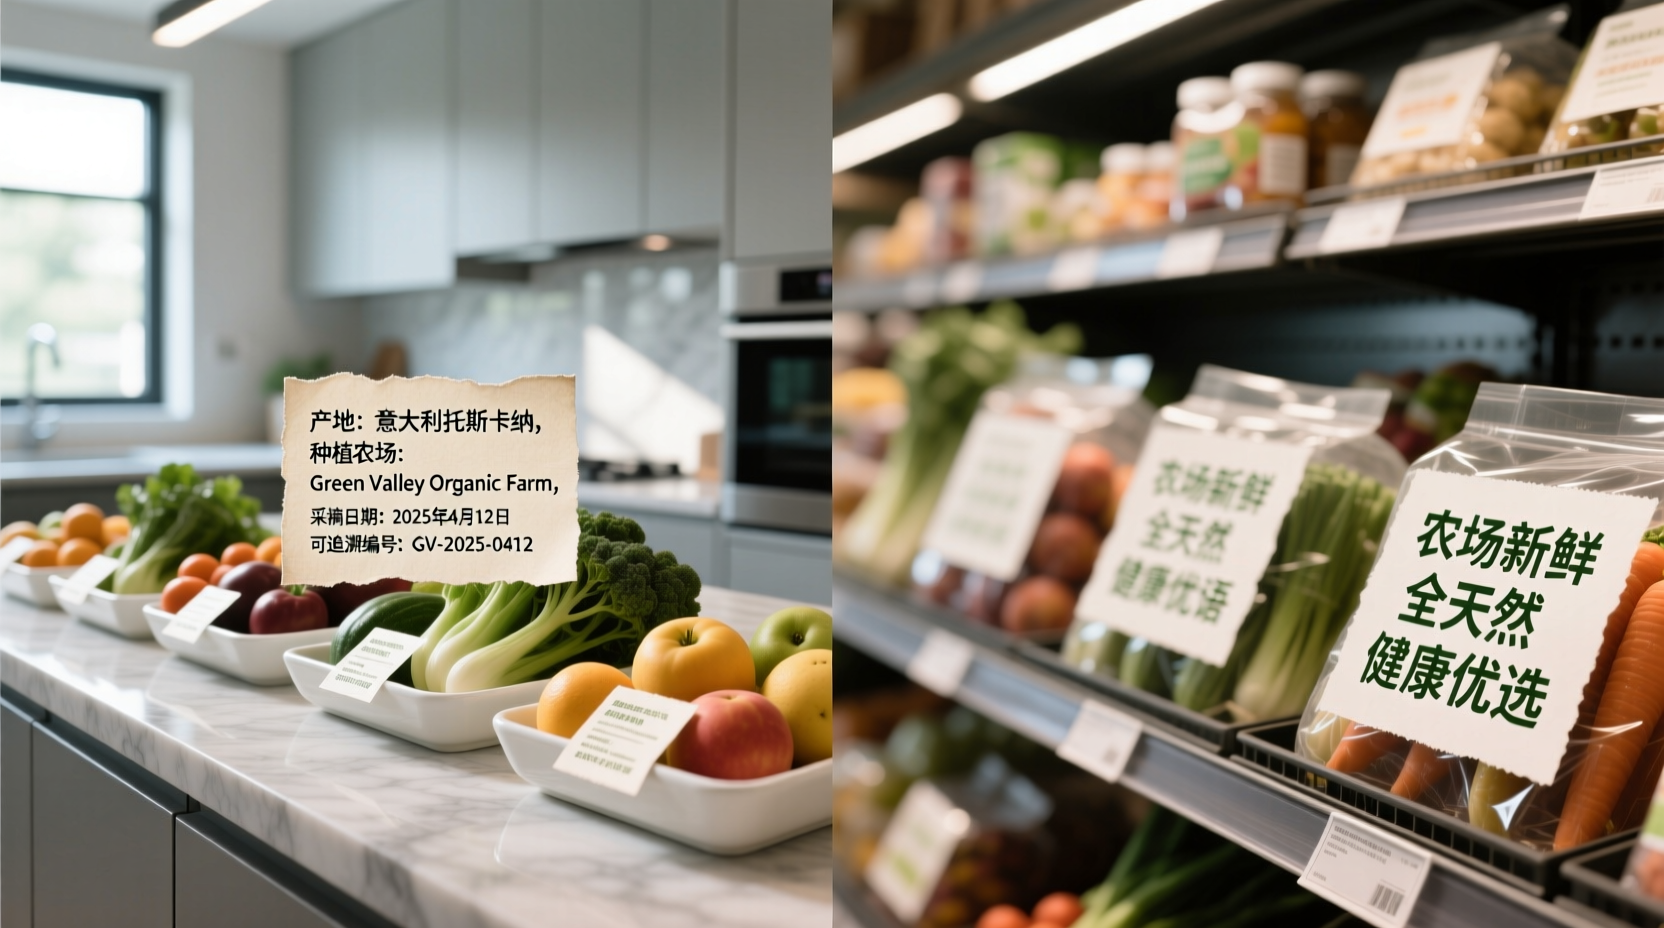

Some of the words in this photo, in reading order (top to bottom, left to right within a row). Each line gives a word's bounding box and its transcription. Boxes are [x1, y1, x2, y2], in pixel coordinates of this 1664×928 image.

[310, 474, 365, 492] Green
[369, 473, 425, 496] Valley
[429, 473, 502, 496] Organic
[506, 474, 559, 495] Farm,
[1141, 509, 1234, 563] 全天然
[1417, 509, 1604, 586] 农场新鲜
[1398, 572, 1545, 650] 全天然
[1360, 630, 1551, 729] 健康优选
